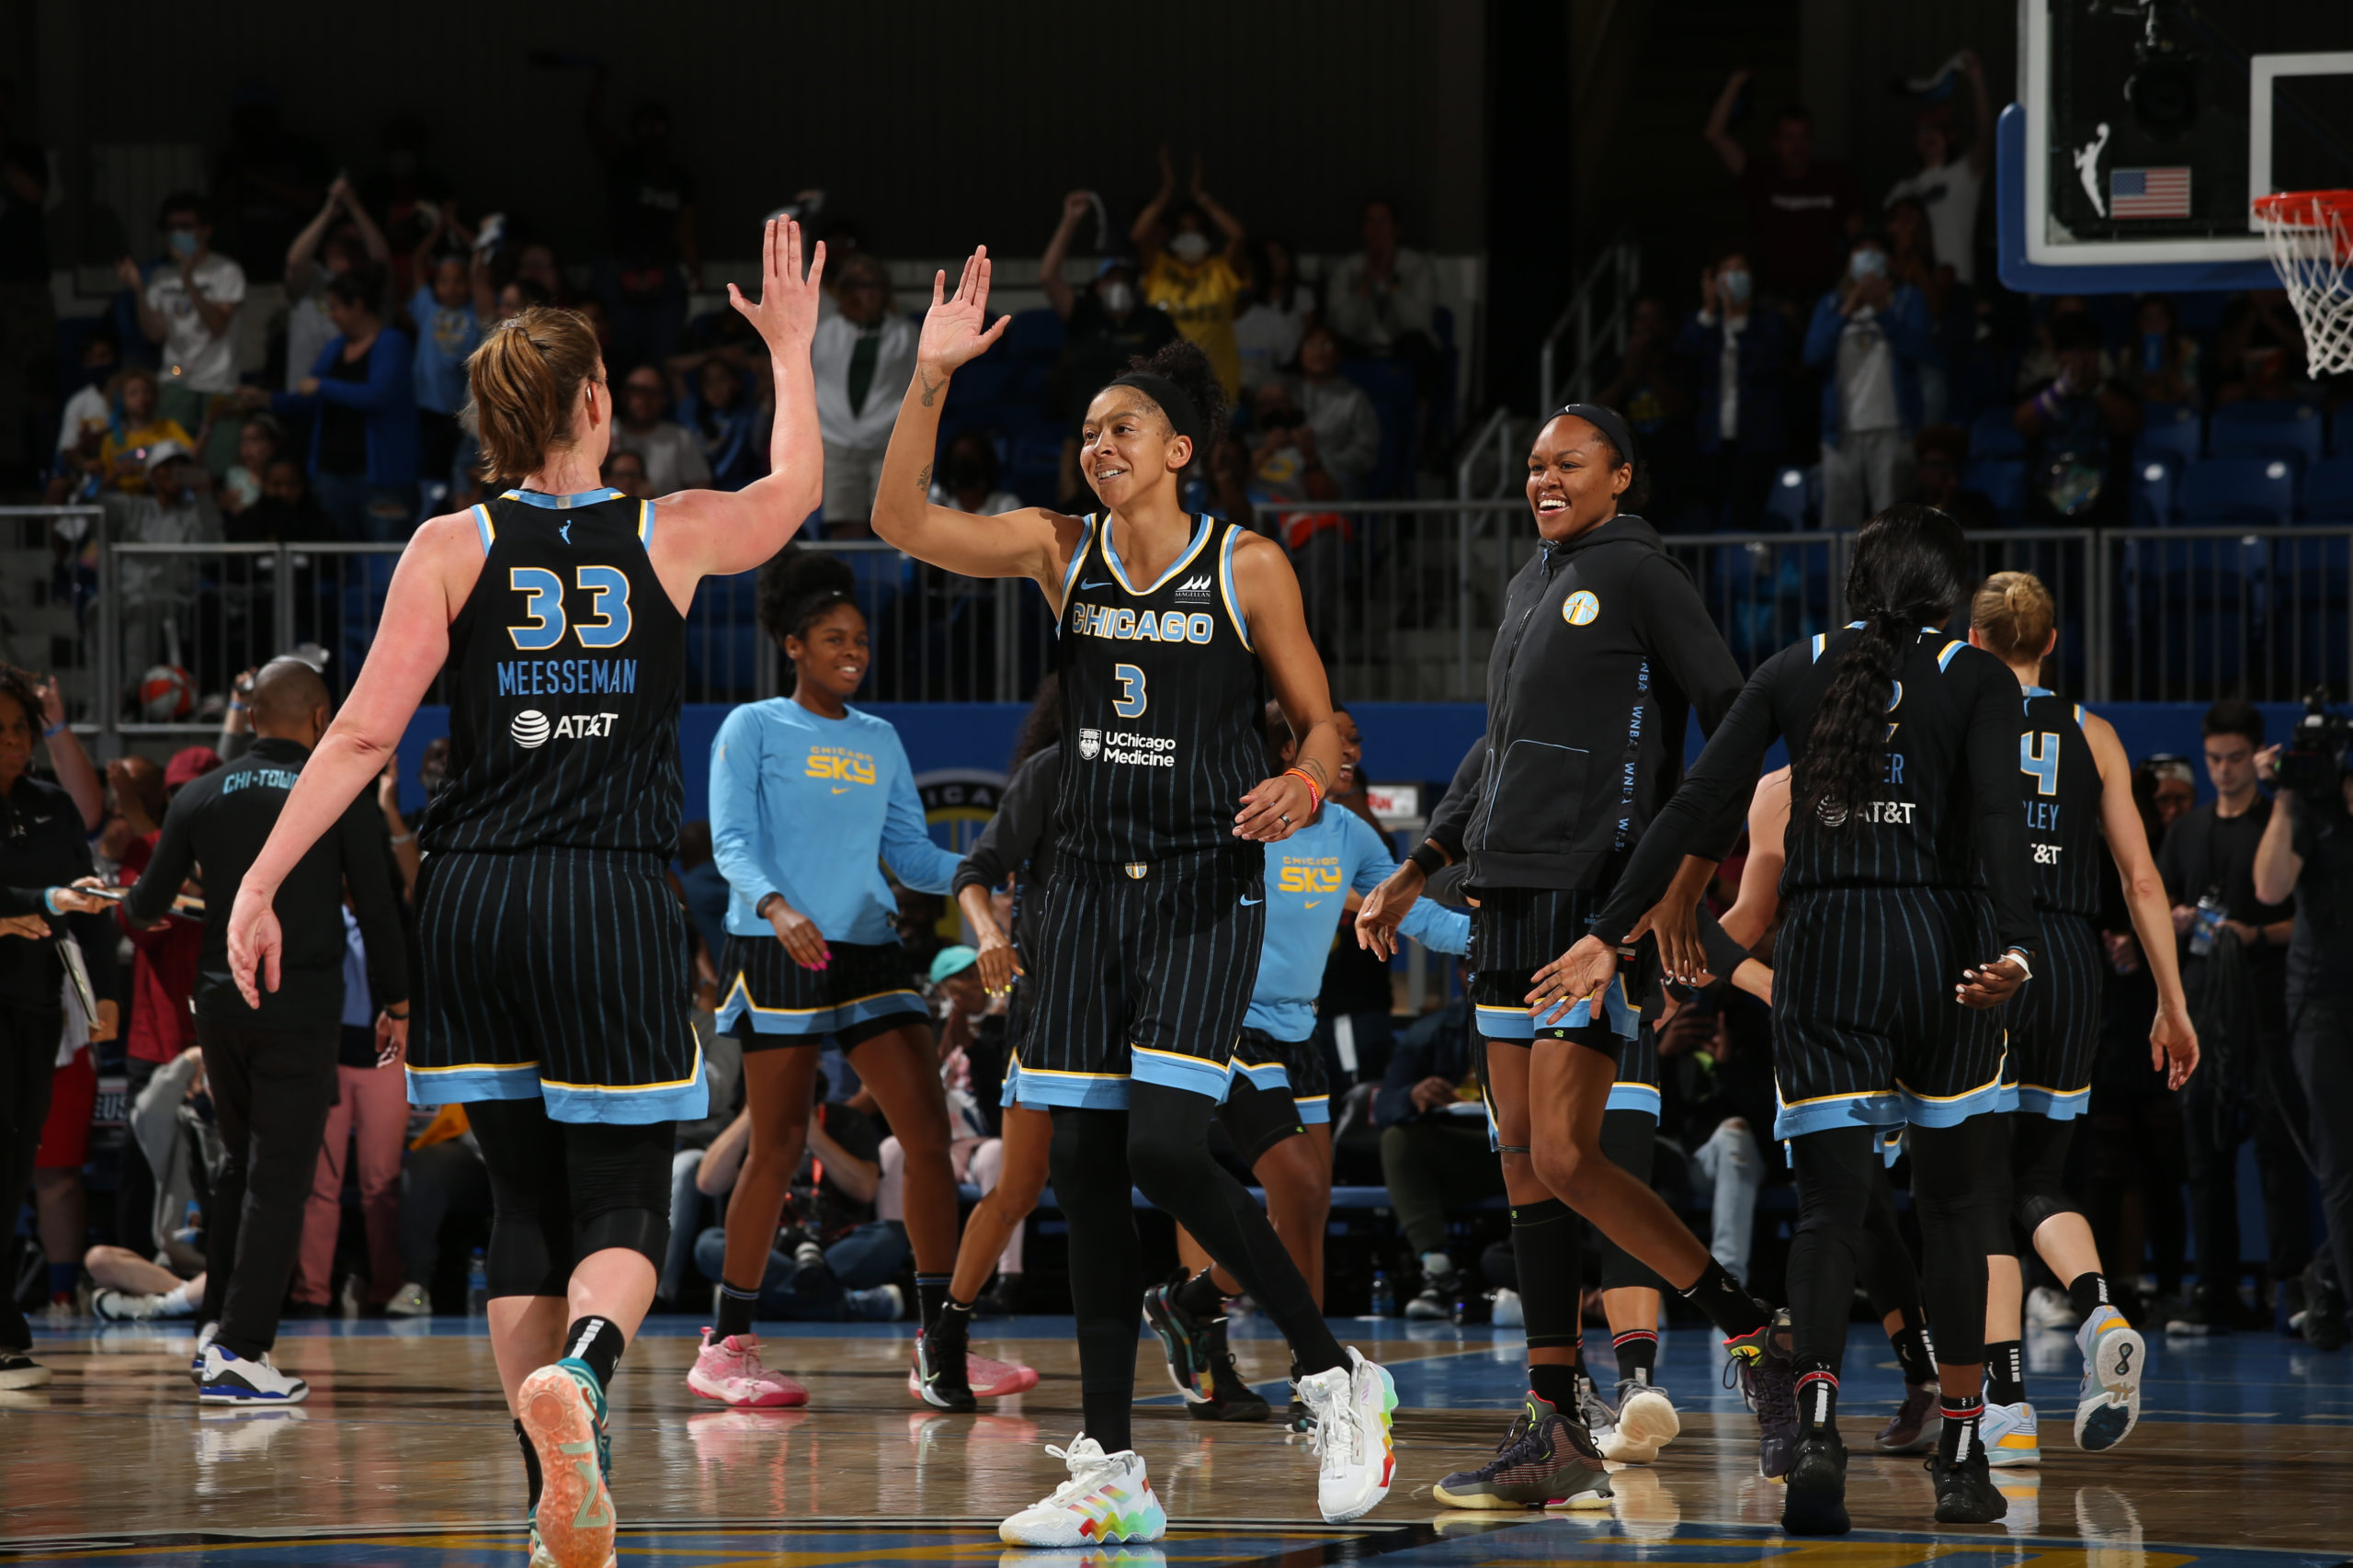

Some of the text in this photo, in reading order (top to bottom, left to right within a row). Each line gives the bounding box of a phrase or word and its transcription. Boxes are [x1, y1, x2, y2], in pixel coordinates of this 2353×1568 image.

[506, 564, 634, 651] 33
[1072, 601, 1214, 645] CHICAGO
[496, 658, 638, 697] MEESSEMAN
[1111, 663, 1148, 719] 3
[552, 711, 620, 739] AT&T
[1105, 731, 1176, 752] UChicago
[1103, 747, 1175, 767] Medicine
